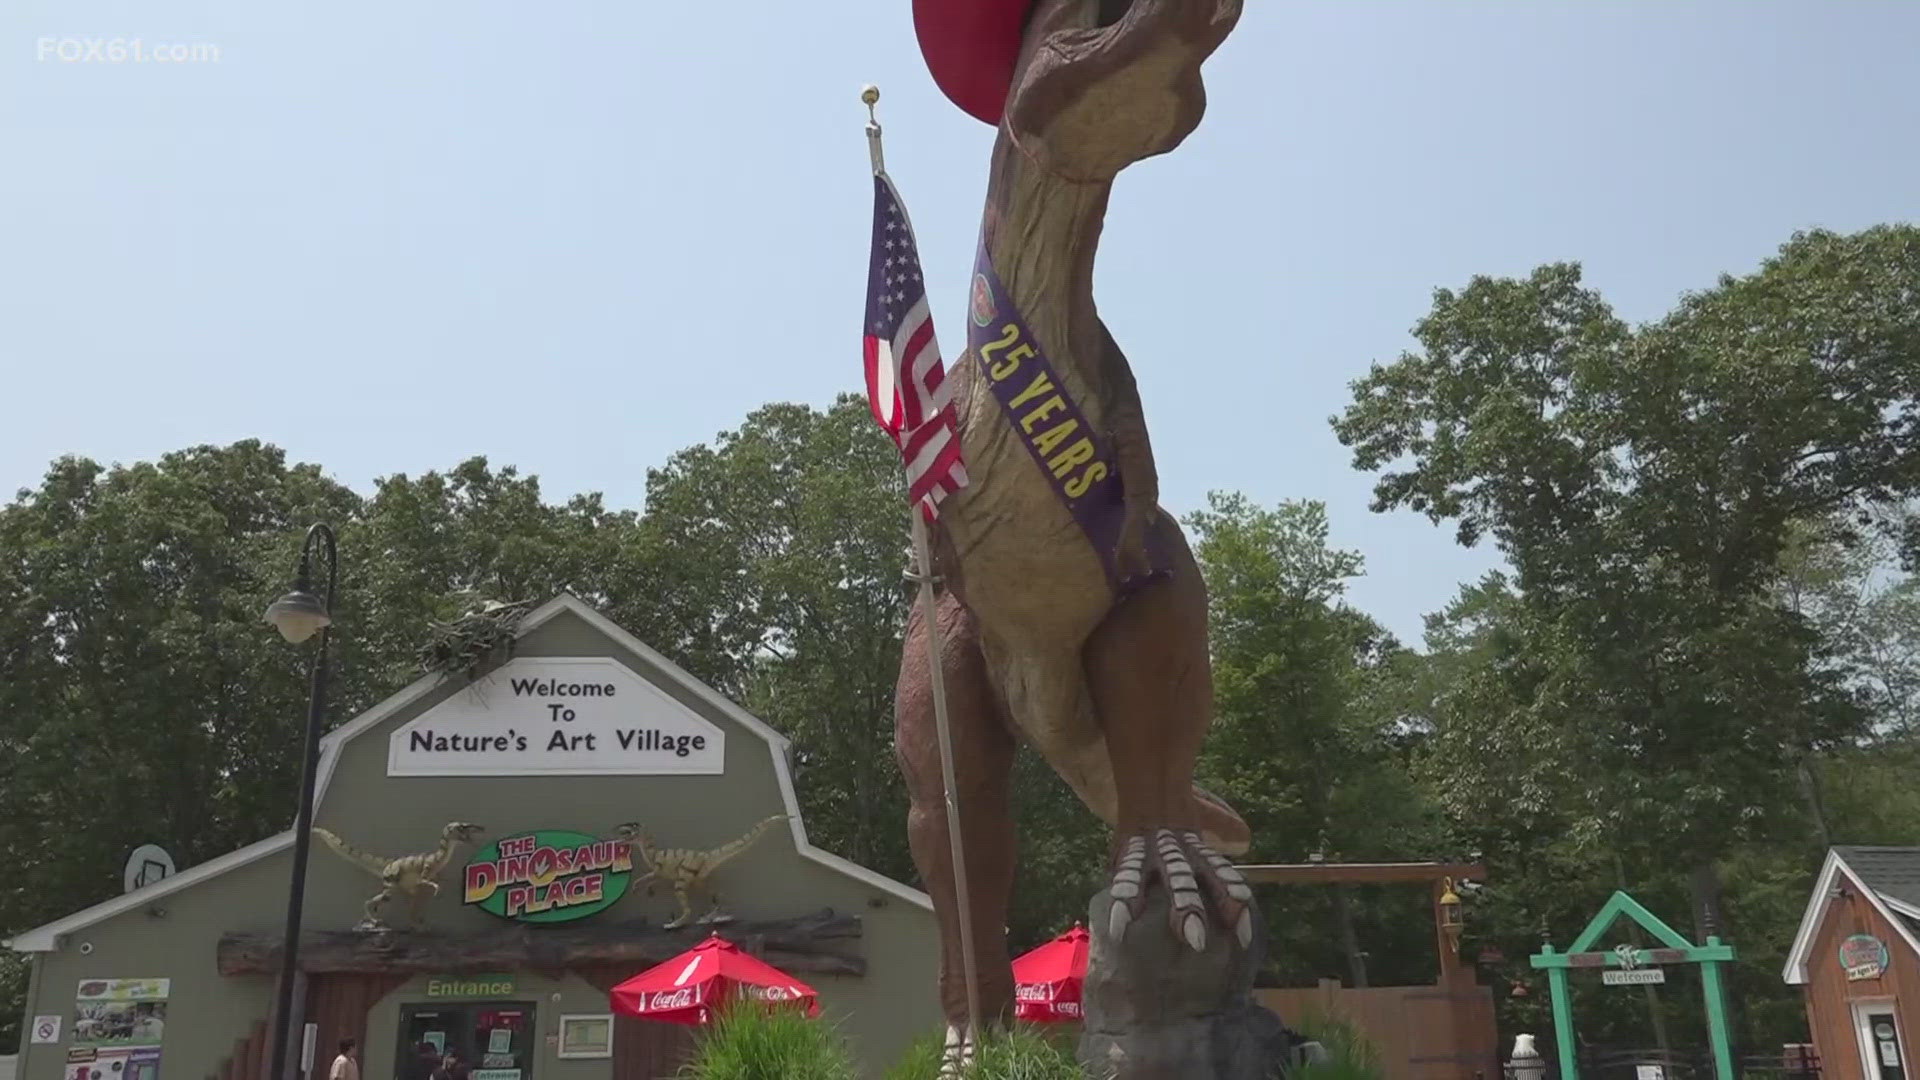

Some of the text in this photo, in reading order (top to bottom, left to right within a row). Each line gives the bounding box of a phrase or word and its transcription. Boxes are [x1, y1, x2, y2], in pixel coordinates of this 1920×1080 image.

[980, 323, 1108, 498] 25 YEARS
[511, 678, 616, 697] Welcome
[547, 704, 576, 722] To
[409, 729, 706, 757] Nature's Art Village
[500, 836, 535, 857] THE
[465, 841, 632, 902] DINOSAUR
[507, 874, 602, 916] PLACE
[1605, 971, 1661, 983] Welcome
[428, 980, 513, 996] Entrance
